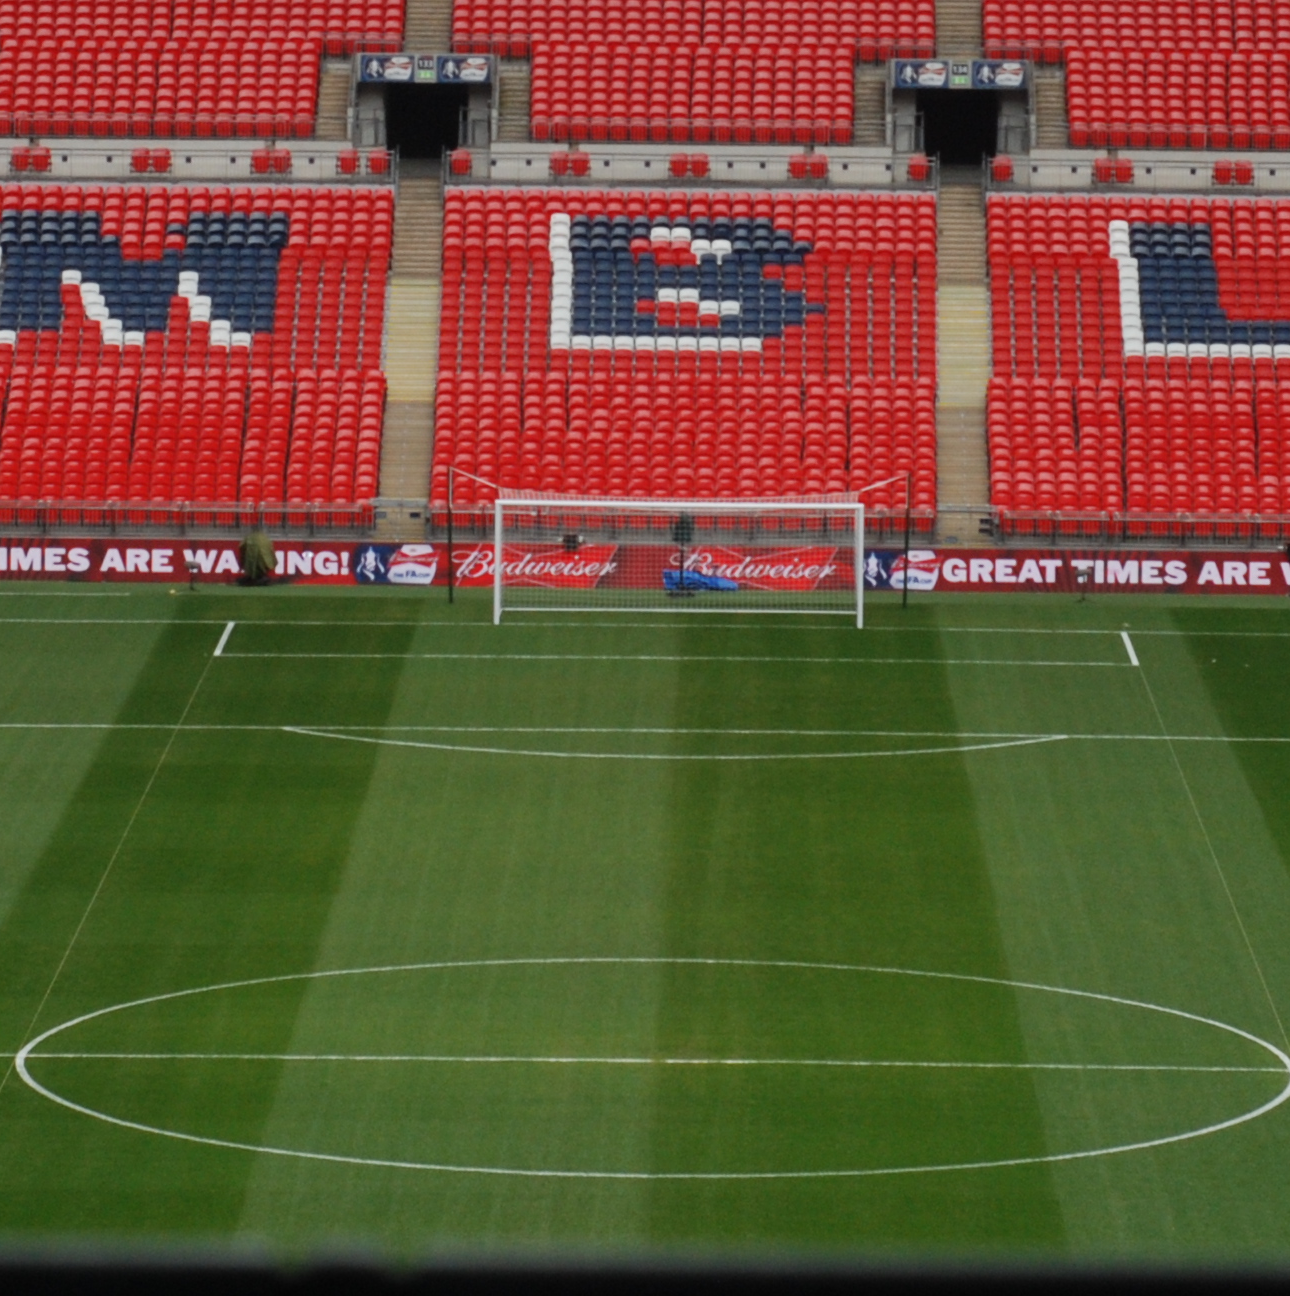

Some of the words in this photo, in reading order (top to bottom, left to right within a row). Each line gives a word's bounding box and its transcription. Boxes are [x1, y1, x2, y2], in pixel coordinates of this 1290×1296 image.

[99, 548, 174, 573] ARE
[183, 549, 350, 575] WAING!
[452, 549, 618, 578] Budweiser
[669, 552, 837, 579] Budweiser
[942, 558, 1062, 583] GREAT
[1071, 559, 1187, 585] TIMES
[1197, 560, 1271, 586] ARE
